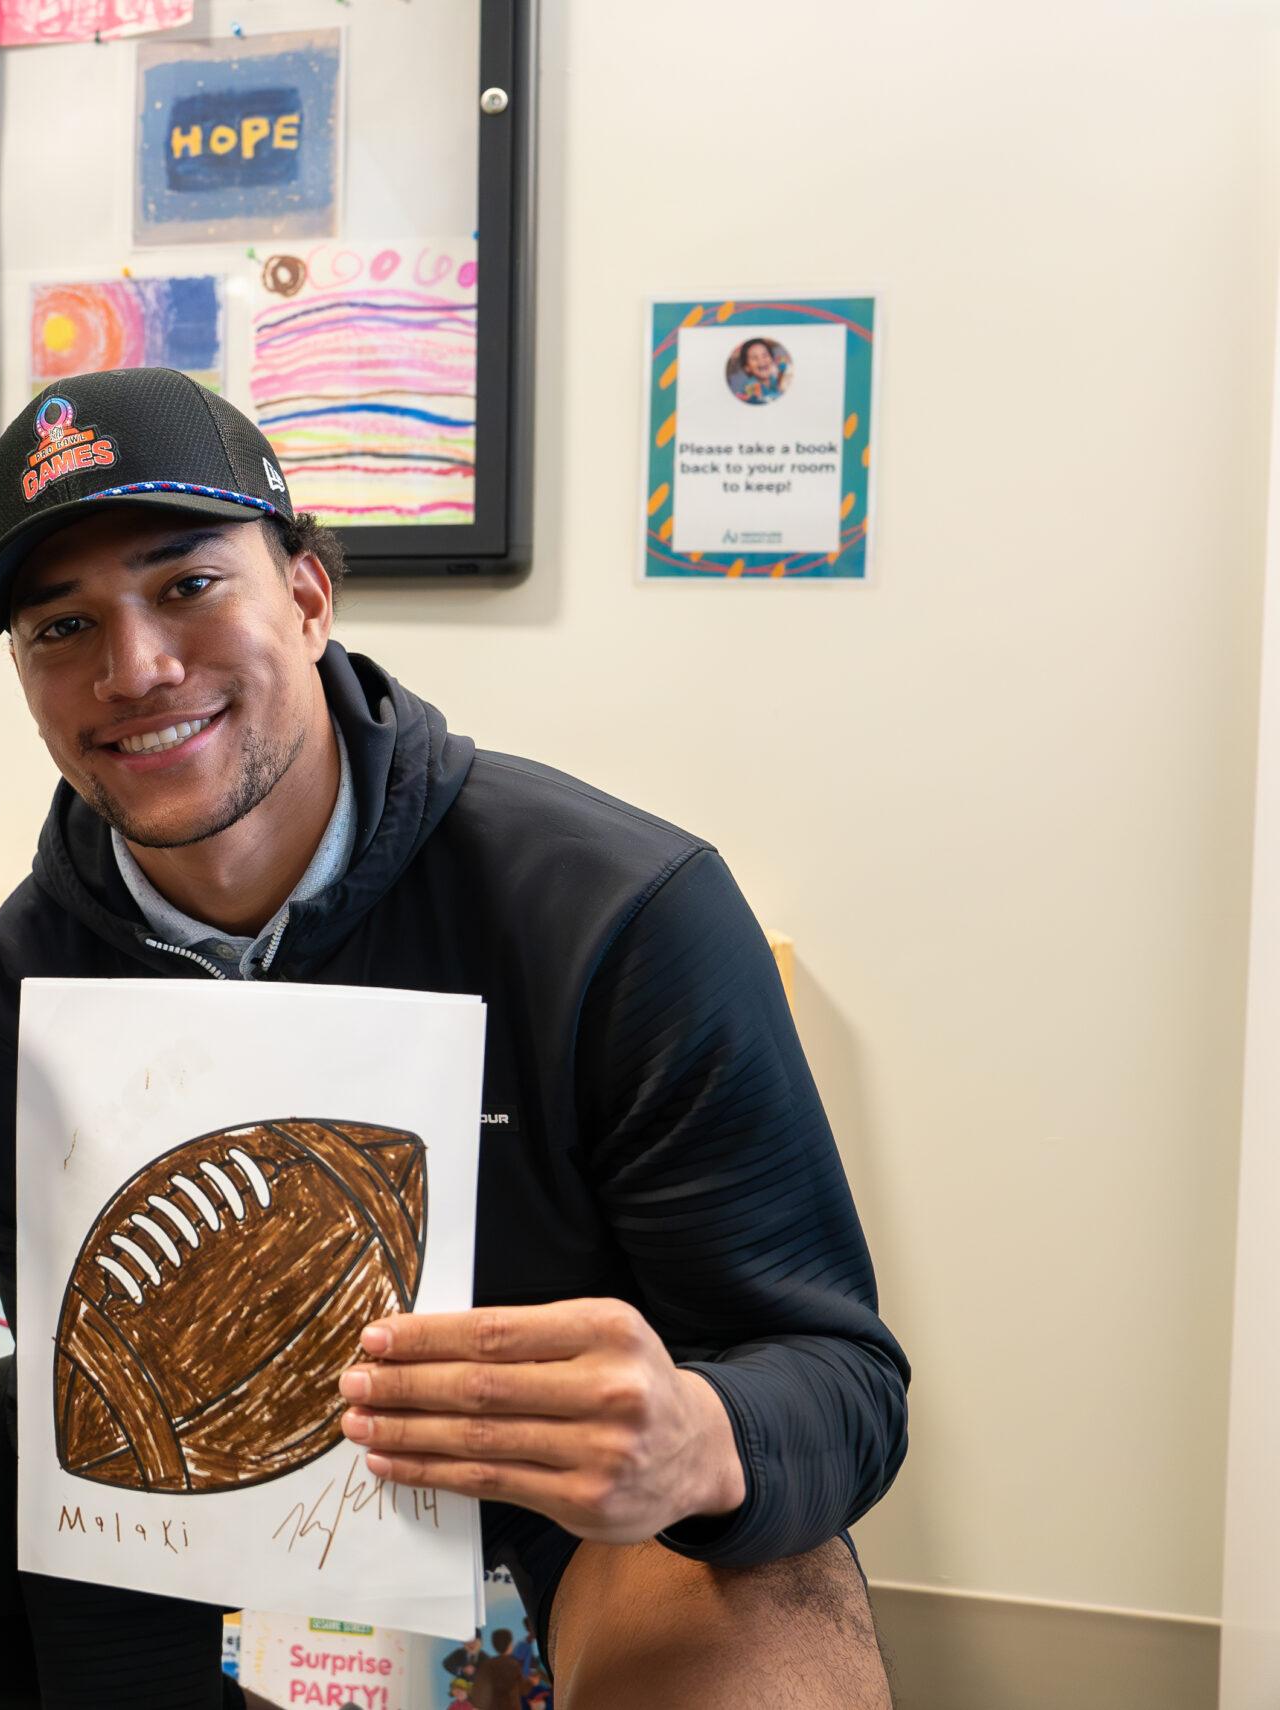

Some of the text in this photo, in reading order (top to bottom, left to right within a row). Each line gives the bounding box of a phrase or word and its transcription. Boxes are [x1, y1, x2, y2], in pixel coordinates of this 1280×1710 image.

[169, 114, 301, 159] HOPE
[678, 441, 839, 456] Please take a book
[22, 439, 115, 500] GAMES
[680, 460, 836, 477] back to your room
[722, 480, 793, 494] to keep!
[290, 1645, 393, 1676] Surprise
[289, 1680, 389, 1710] PARTY!
